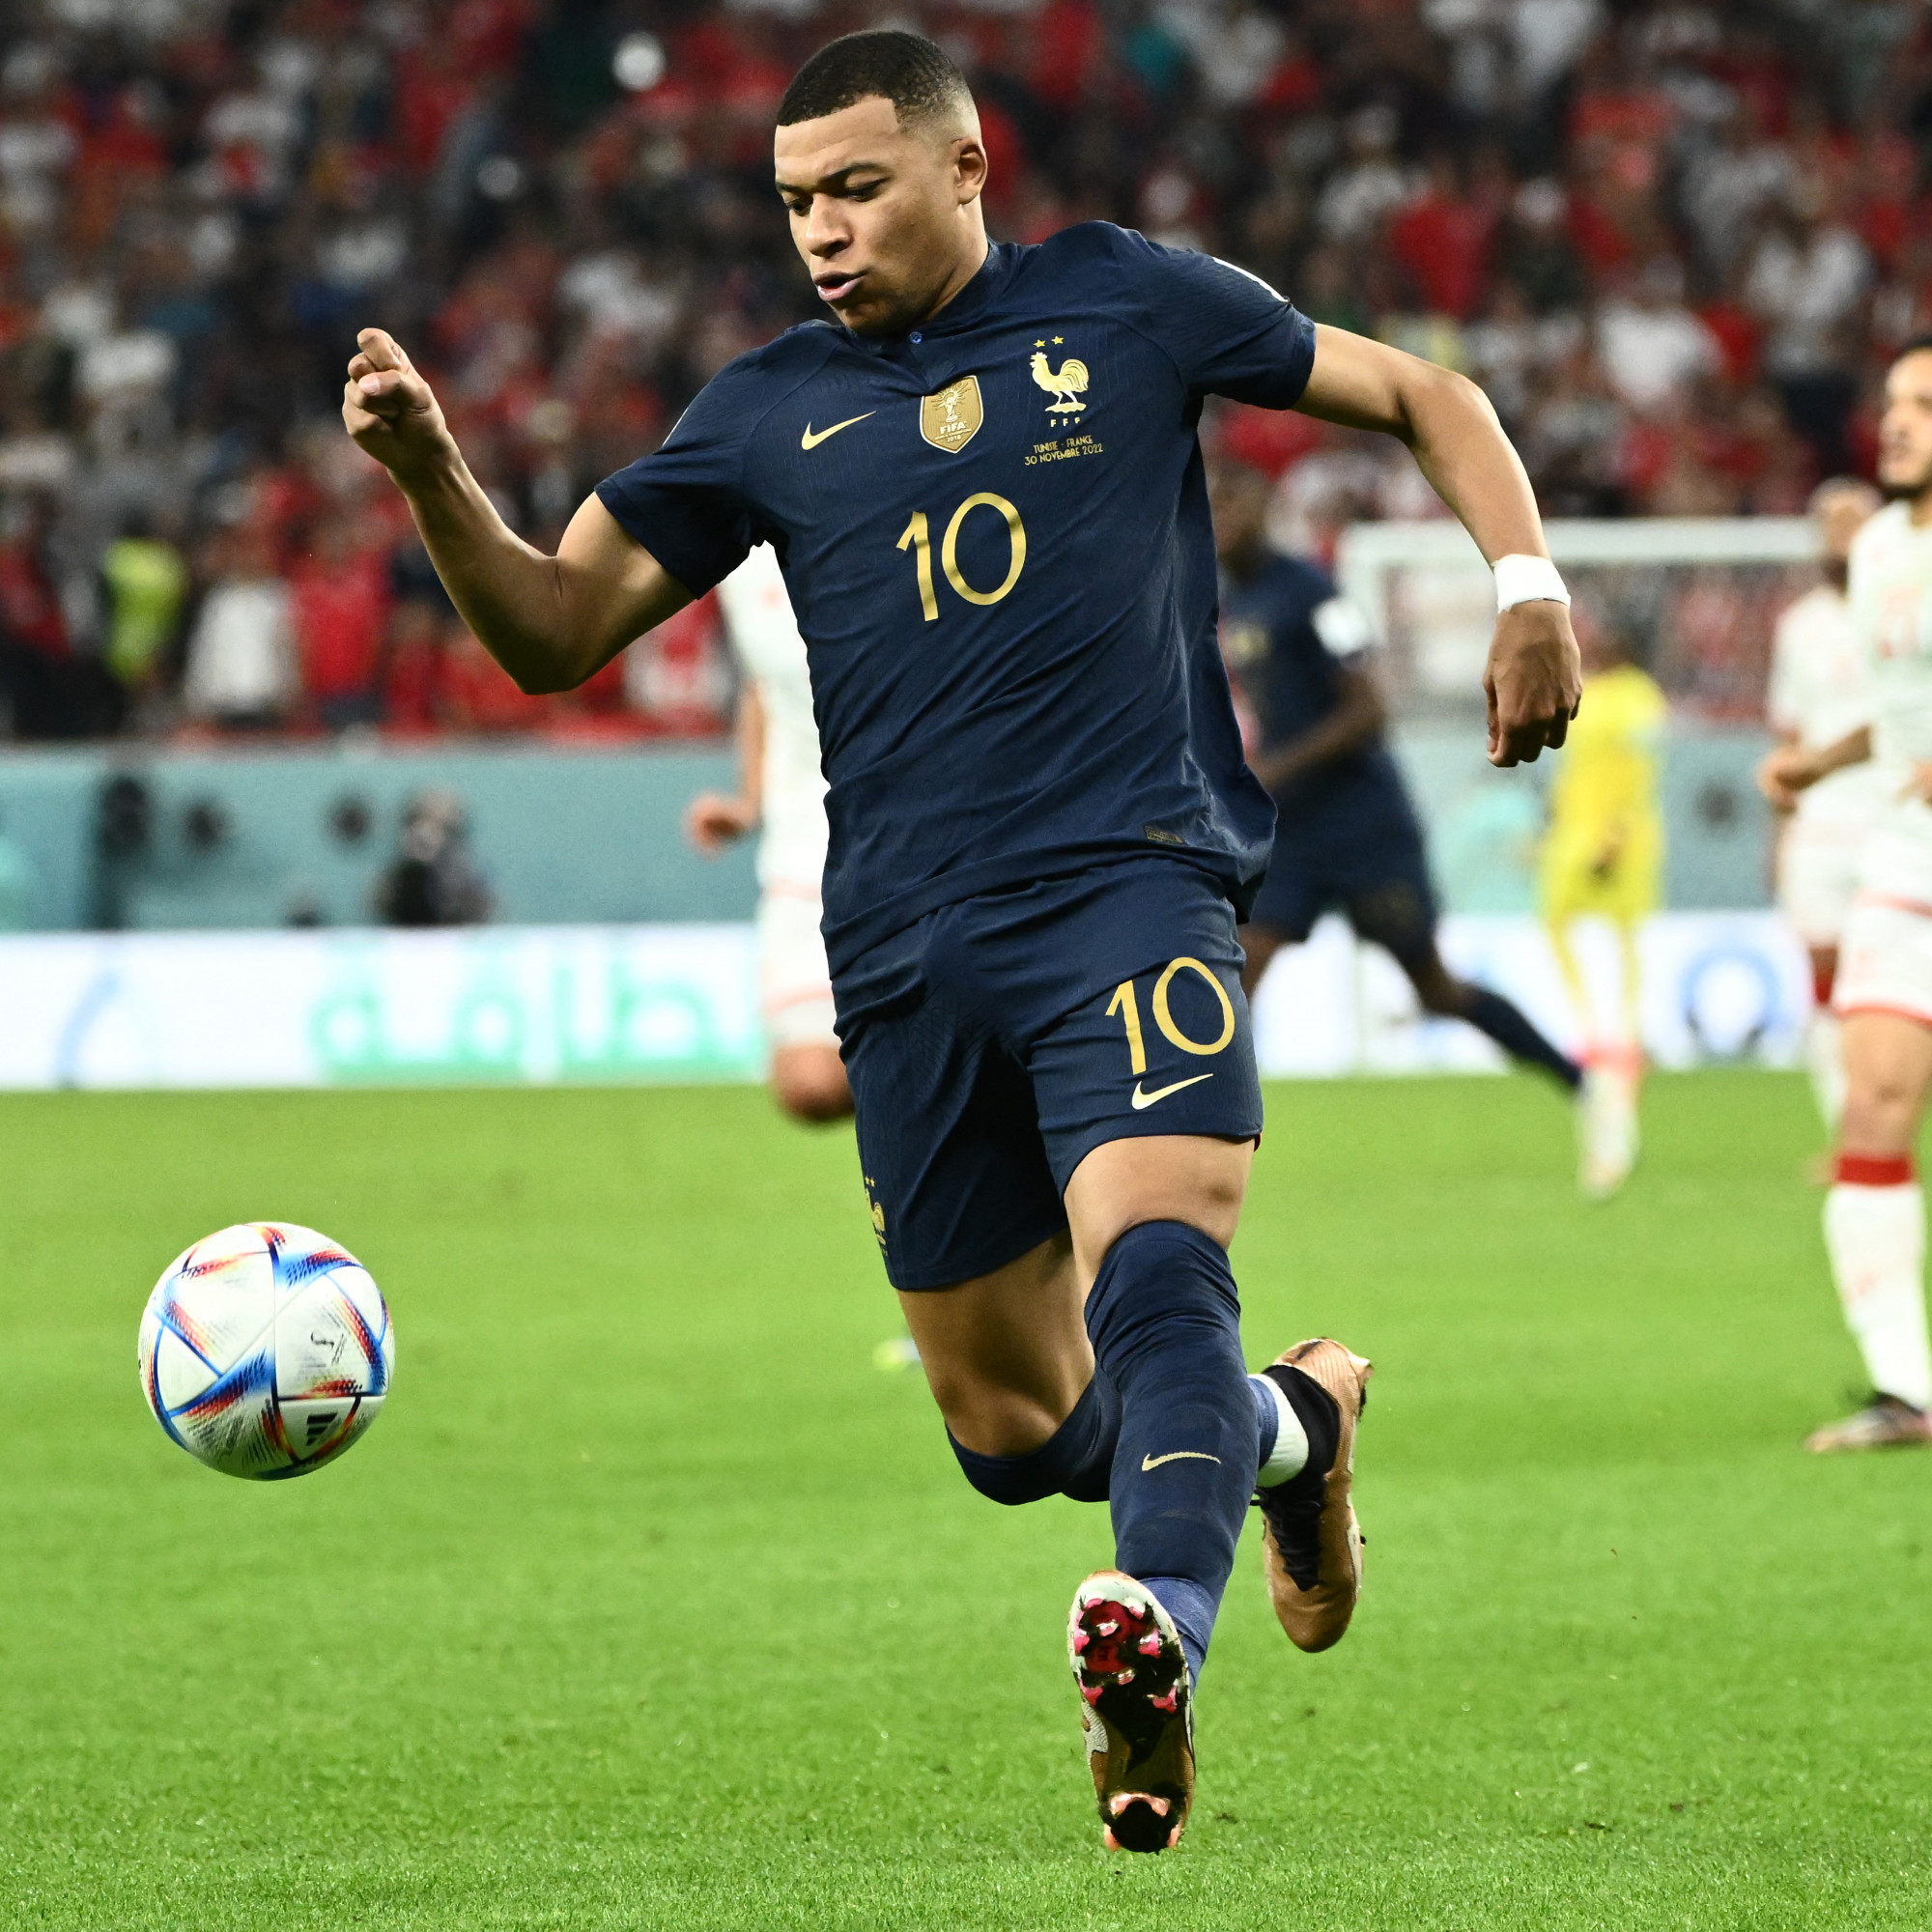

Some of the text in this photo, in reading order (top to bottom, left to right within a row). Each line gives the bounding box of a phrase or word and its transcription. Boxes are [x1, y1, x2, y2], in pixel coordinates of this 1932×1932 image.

[940, 421, 966, 435] FIFA
[1024, 442, 1104, 466] 30 NOVEMBRE 2022
[1033, 440, 1059, 454] TUNISIE
[1065, 435, 1094, 448] FRANCE
[895, 492, 1027, 621] 10
[1105, 956, 1236, 1075] 10
